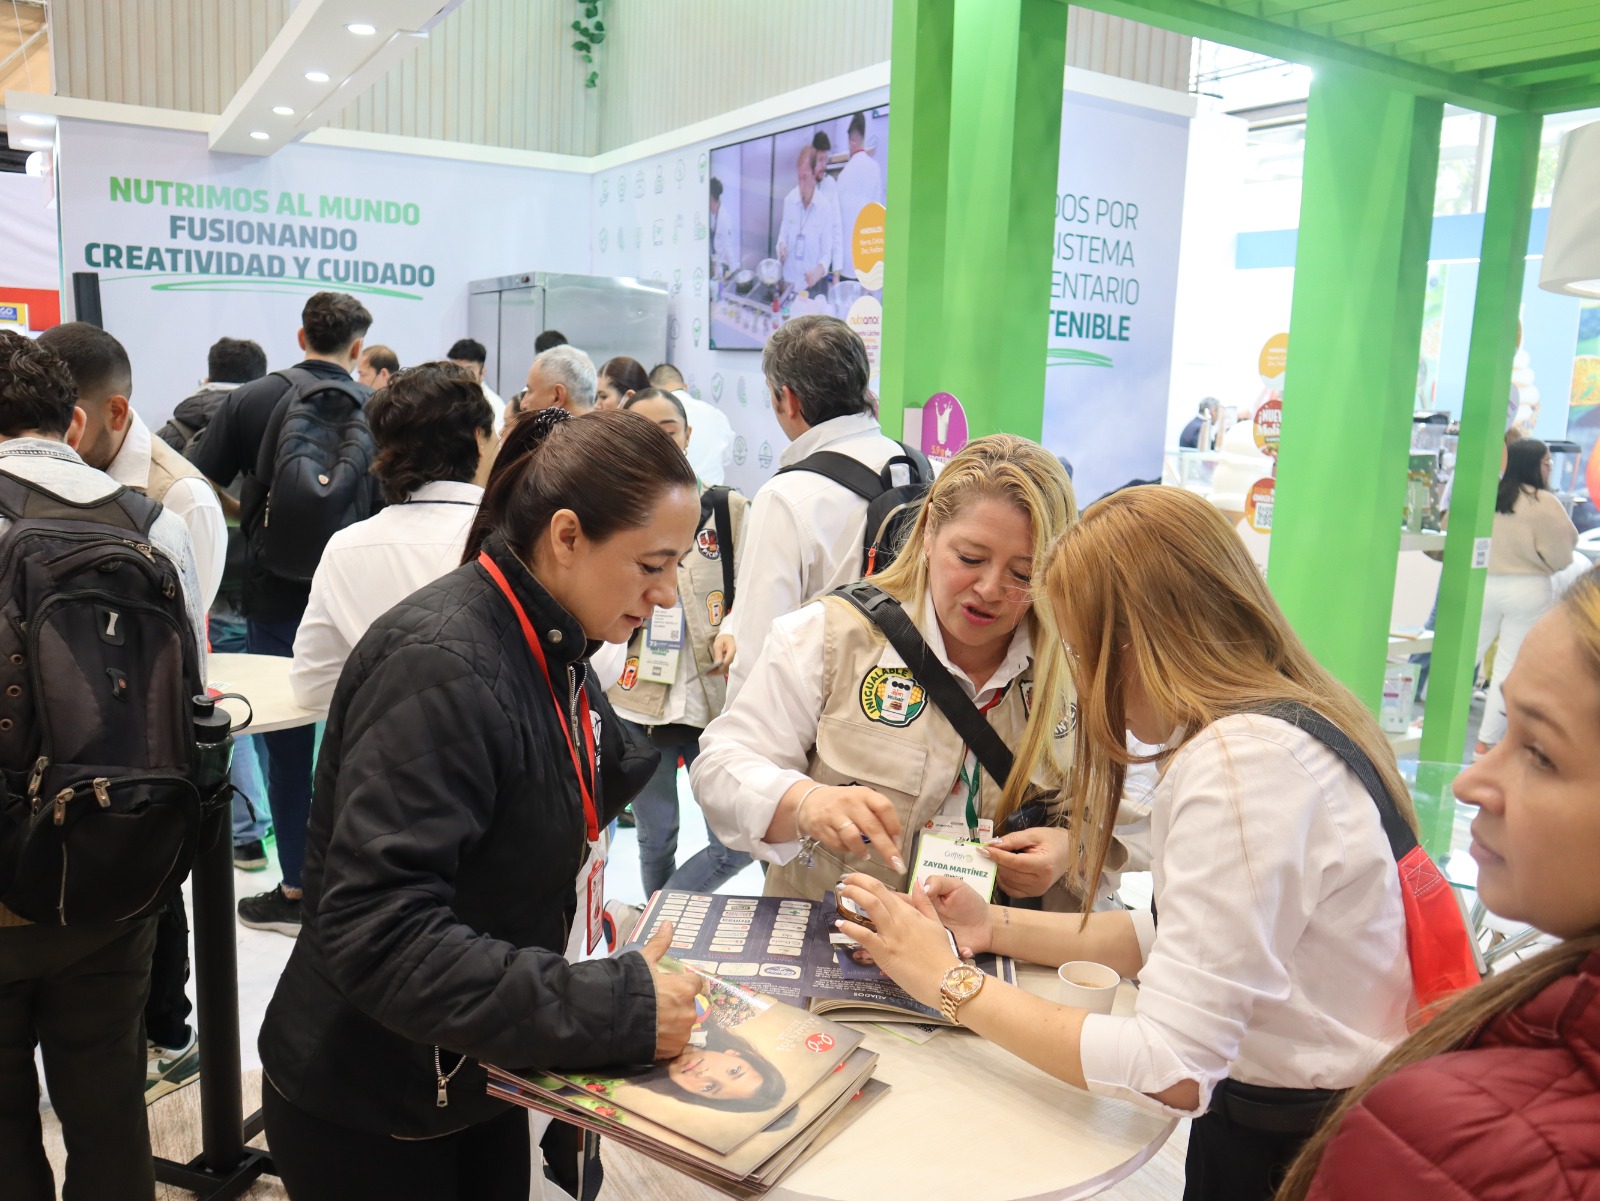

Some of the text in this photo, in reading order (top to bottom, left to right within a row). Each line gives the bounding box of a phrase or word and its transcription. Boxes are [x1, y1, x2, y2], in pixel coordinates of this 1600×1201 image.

[109, 176, 421, 226] NUTRIMOS AL MUNDO
[1096, 198, 1139, 230] POR
[169, 215, 358, 252] FUSIONANDO
[1054, 232, 1135, 268] ISTEMA
[84, 242, 435, 288] CREATIVIDAD Y CUIDADO
[1049, 309, 1131, 341] ENIBLE
[864, 667, 909, 714] INIGUALABLE
[923, 860, 948, 871] ZAYDA
[949, 865, 988, 879] MARTÍNEZ
[853, 992, 887, 1001] ALIADOS
